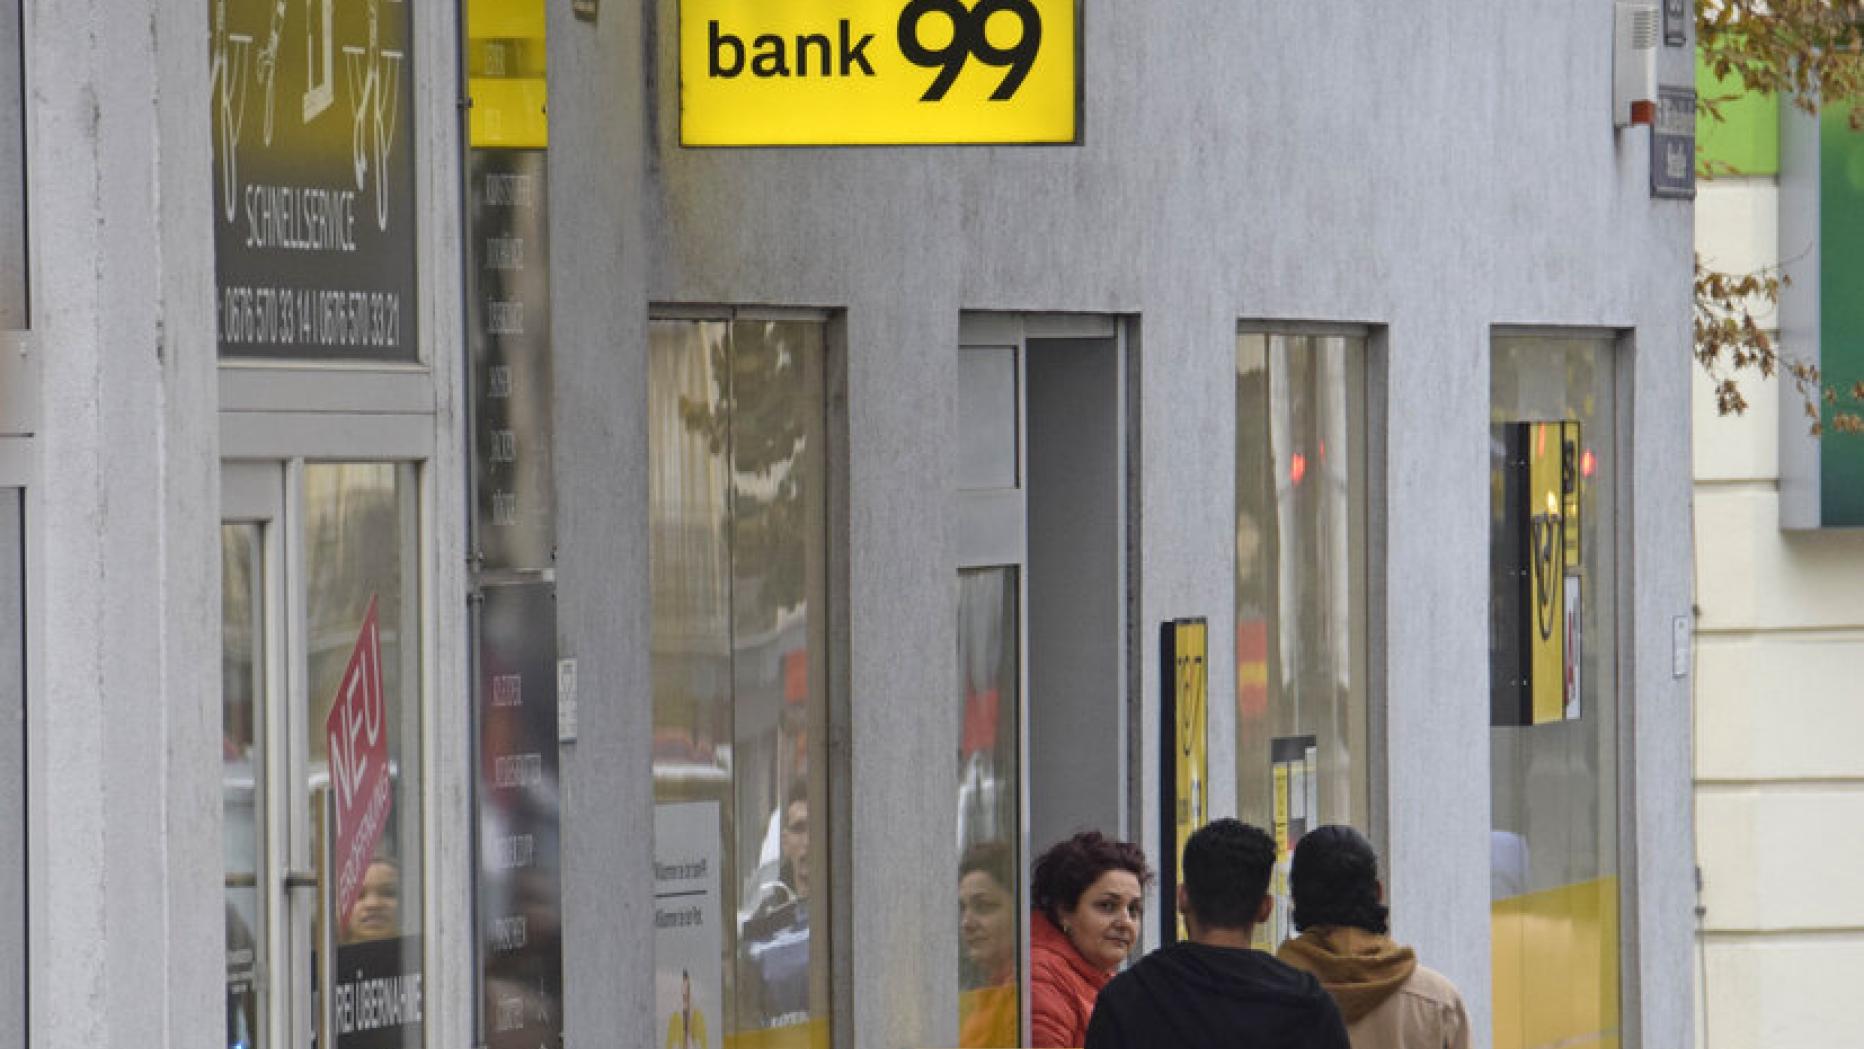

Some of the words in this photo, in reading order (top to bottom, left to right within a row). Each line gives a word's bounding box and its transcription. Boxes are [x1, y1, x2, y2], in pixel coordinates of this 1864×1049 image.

[708, 19, 876, 78] bank
[897, 0, 1042, 102] 99
[246, 184, 356, 250] SCHNELLSERVICE
[225, 287, 253, 344] 0676
[256, 288, 278, 344] 570
[279, 289, 294, 344] 33
[296, 290, 311, 344] 14
[320, 290, 346, 345] 0676
[348, 292, 368, 346] 570
[371, 293, 384, 346] 33
[386, 293, 400, 346] 21
[330, 623, 381, 838] NEU
[356, 968, 422, 1031] ÜBERNAHME
